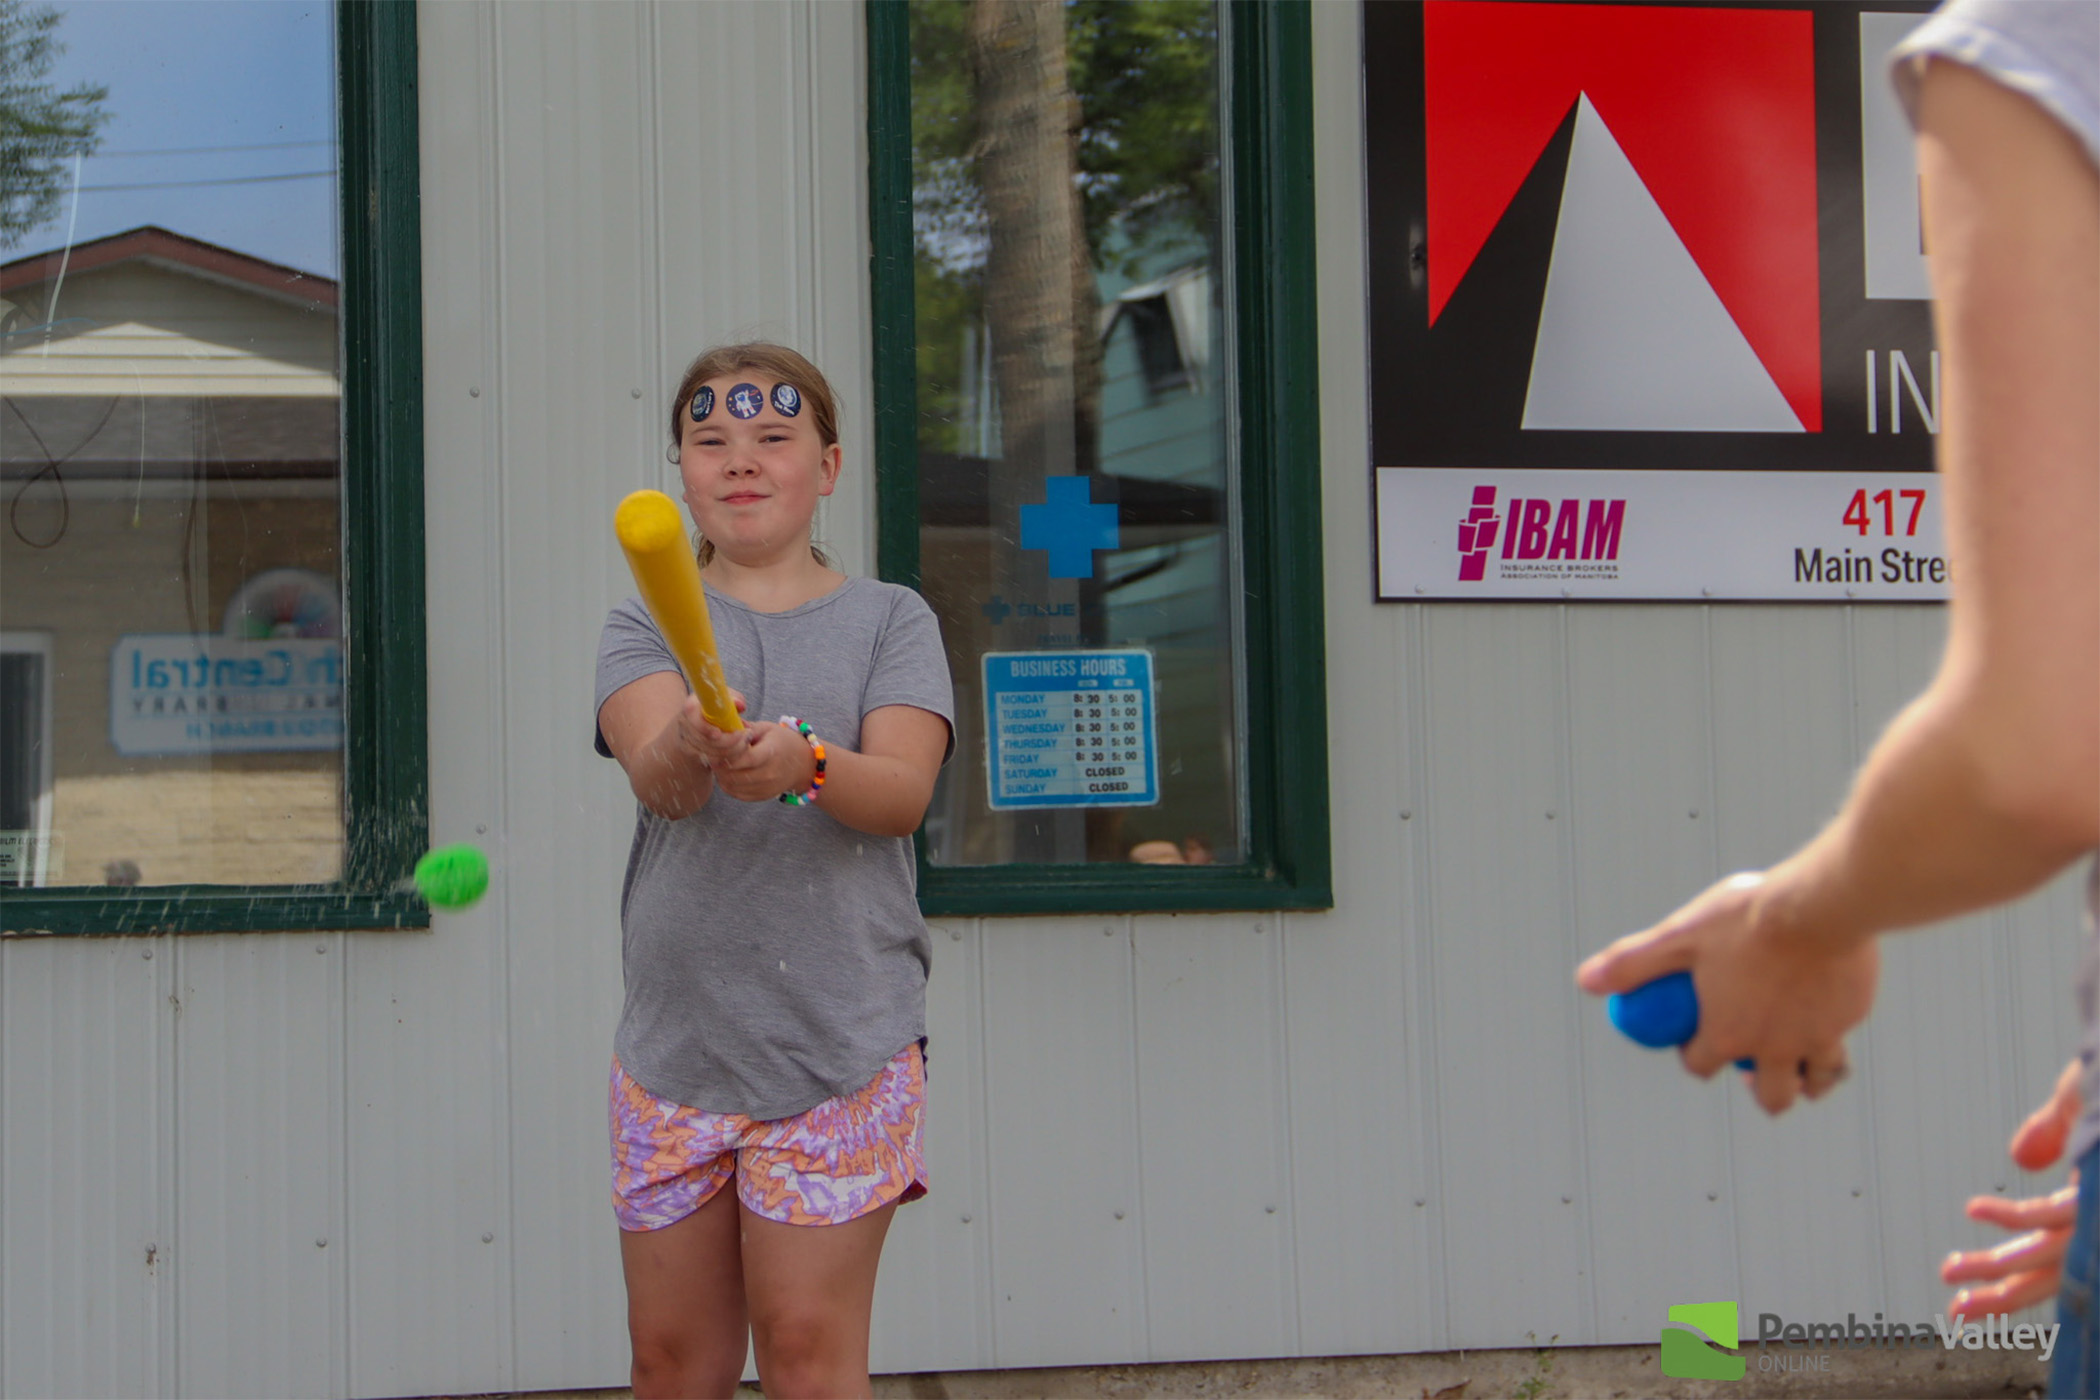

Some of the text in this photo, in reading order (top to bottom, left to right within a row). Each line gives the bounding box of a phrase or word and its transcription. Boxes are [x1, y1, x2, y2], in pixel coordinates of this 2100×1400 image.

[1842, 488, 1926, 536] 417
[1500, 498, 1627, 560] IBAM
[1500, 564, 1619, 572] INSURANCE BROKERS
[1794, 548, 1873, 583] Main
[1010, 658, 1127, 678] BUSINESS HOURS
[1001, 694, 1046, 705] MONDAY
[1002, 708, 1048, 720] TUESDAY
[1002, 723, 1065, 734] WEDNESDAY
[1003, 738, 1058, 749] THURSDAY
[1003, 753, 1039, 765] FRIDAY
[1004, 767, 1125, 780] SATURDAY CLOSED
[1005, 782, 1129, 794] SUNDAY CLOSED
